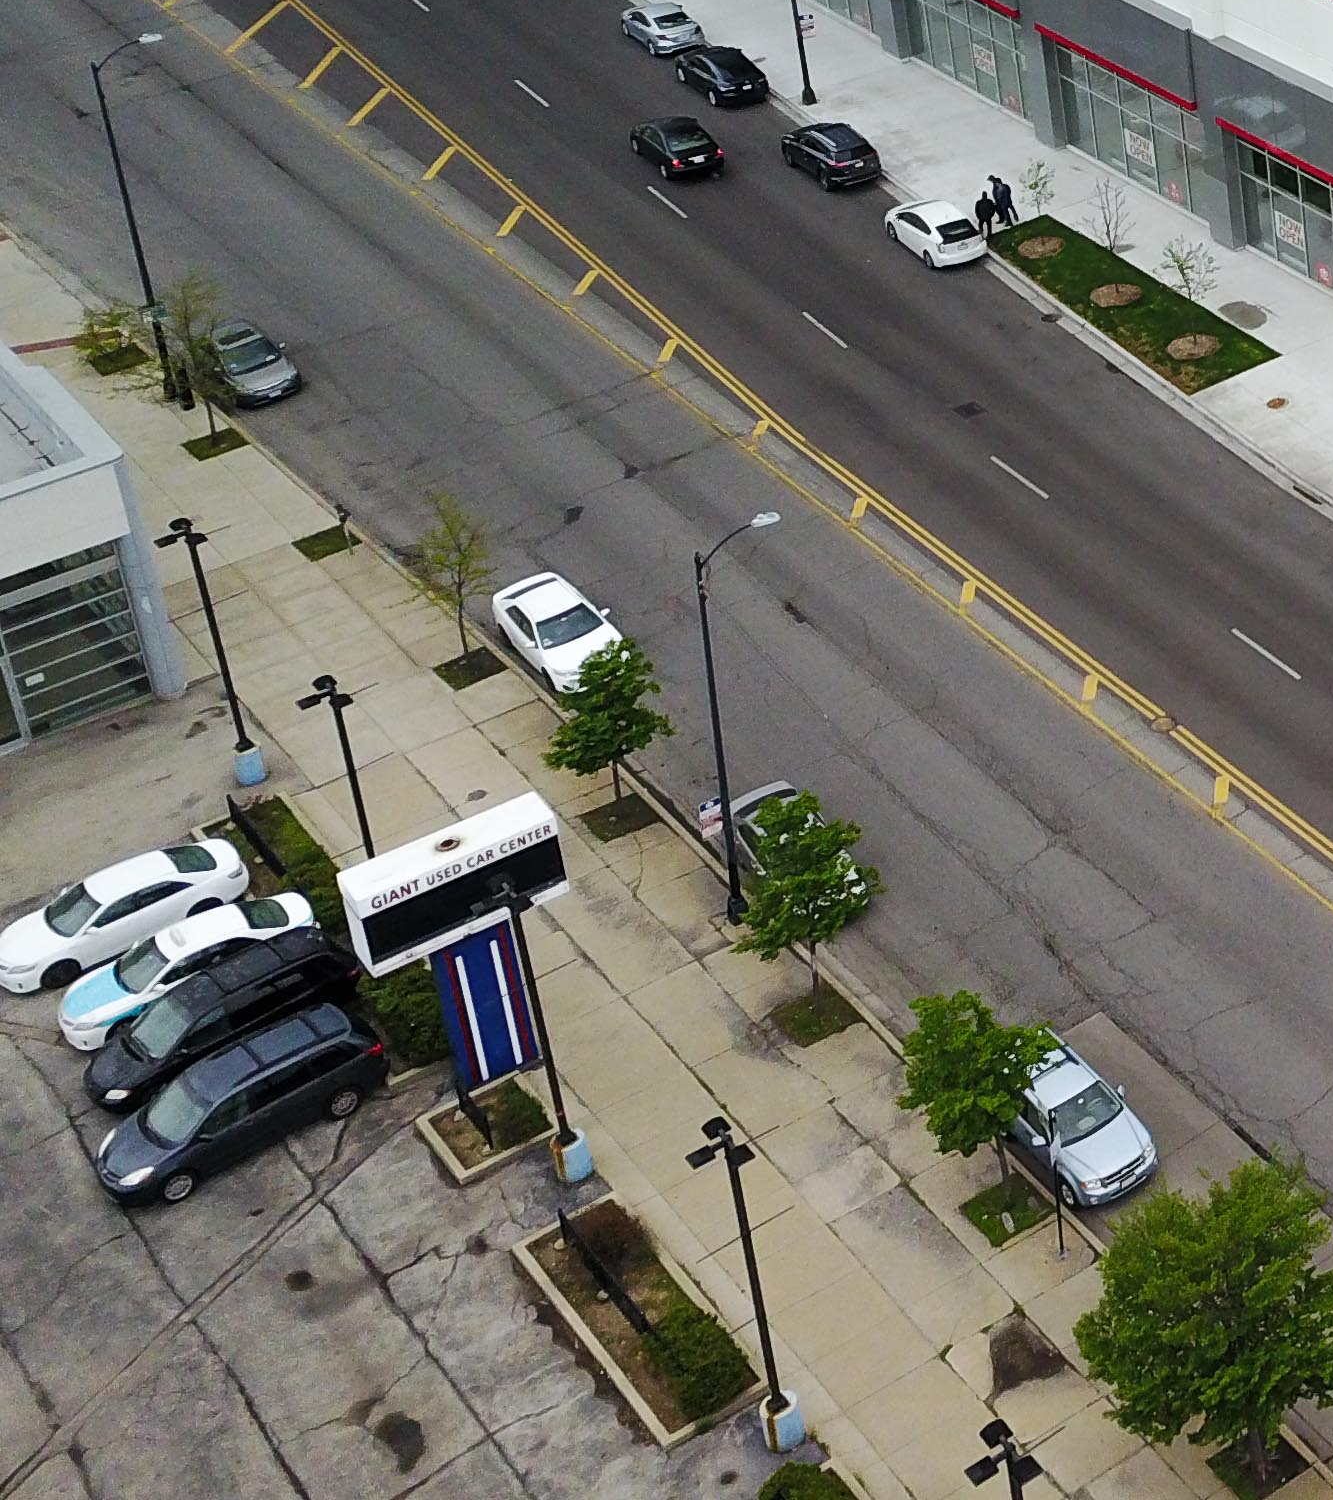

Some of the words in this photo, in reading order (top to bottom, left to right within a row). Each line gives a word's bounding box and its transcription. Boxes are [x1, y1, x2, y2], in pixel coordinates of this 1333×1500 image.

[1280, 214, 1300, 234] NOW
[1280, 227, 1304, 249] OPEN
[371, 879, 420, 910] GIANT
[426, 863, 462, 886] USED
[466, 849, 494, 868] CAR
[499, 824, 552, 854] CENTER
